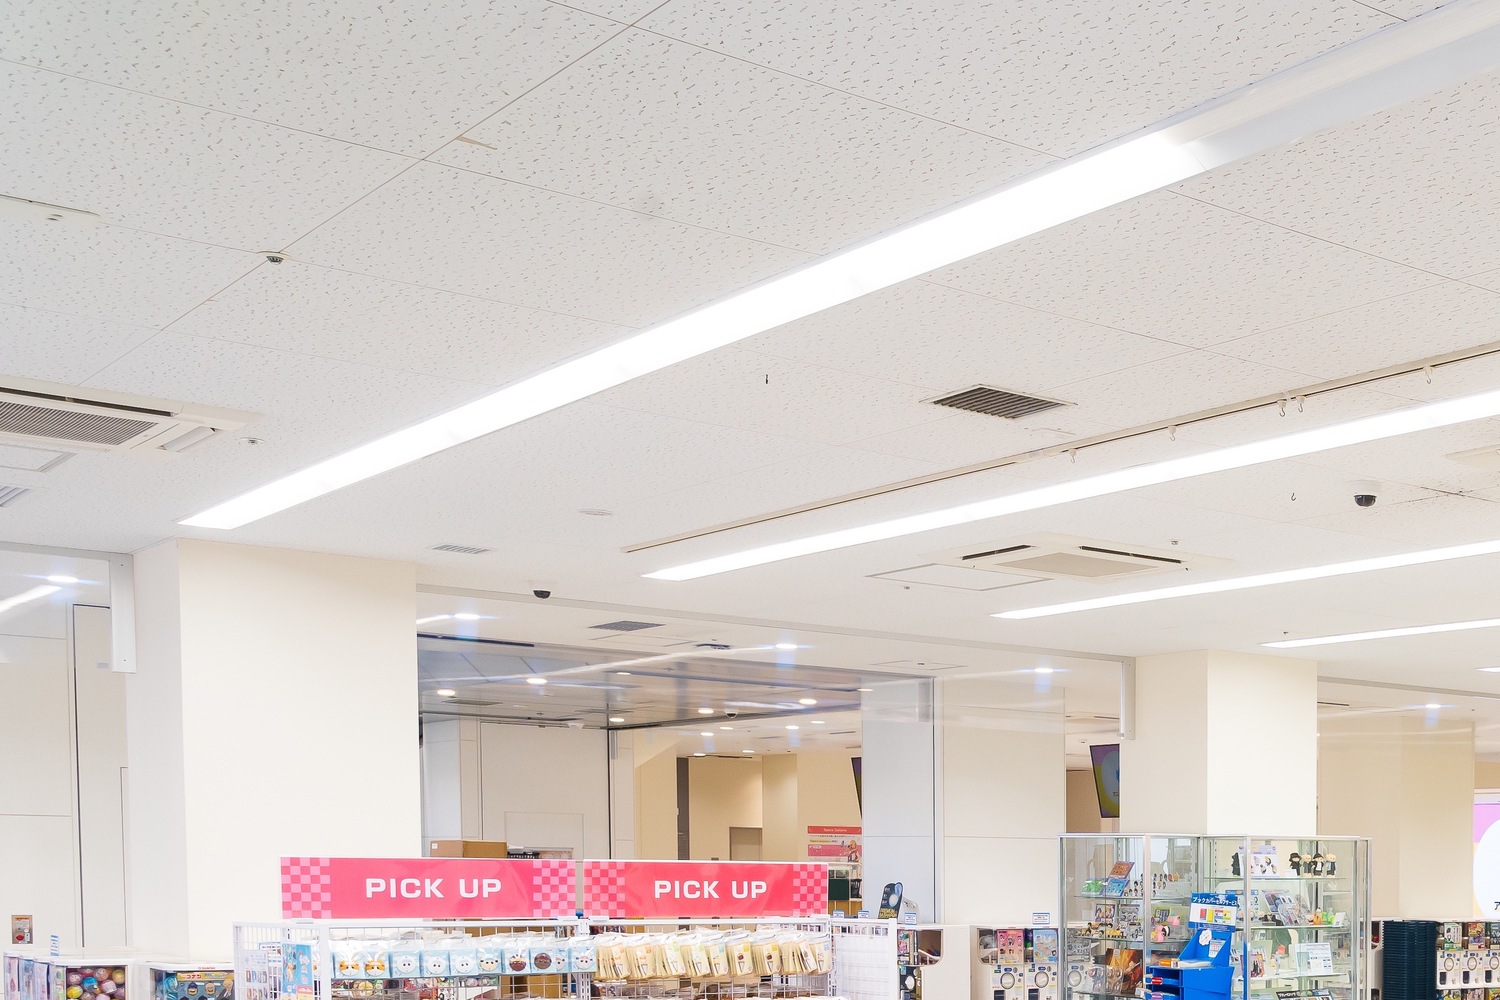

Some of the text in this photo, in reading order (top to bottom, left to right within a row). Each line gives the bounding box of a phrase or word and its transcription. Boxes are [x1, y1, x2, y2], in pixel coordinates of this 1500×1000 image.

[365, 877, 503, 899] PICK UP
[653, 879, 768, 899] PICK UP
